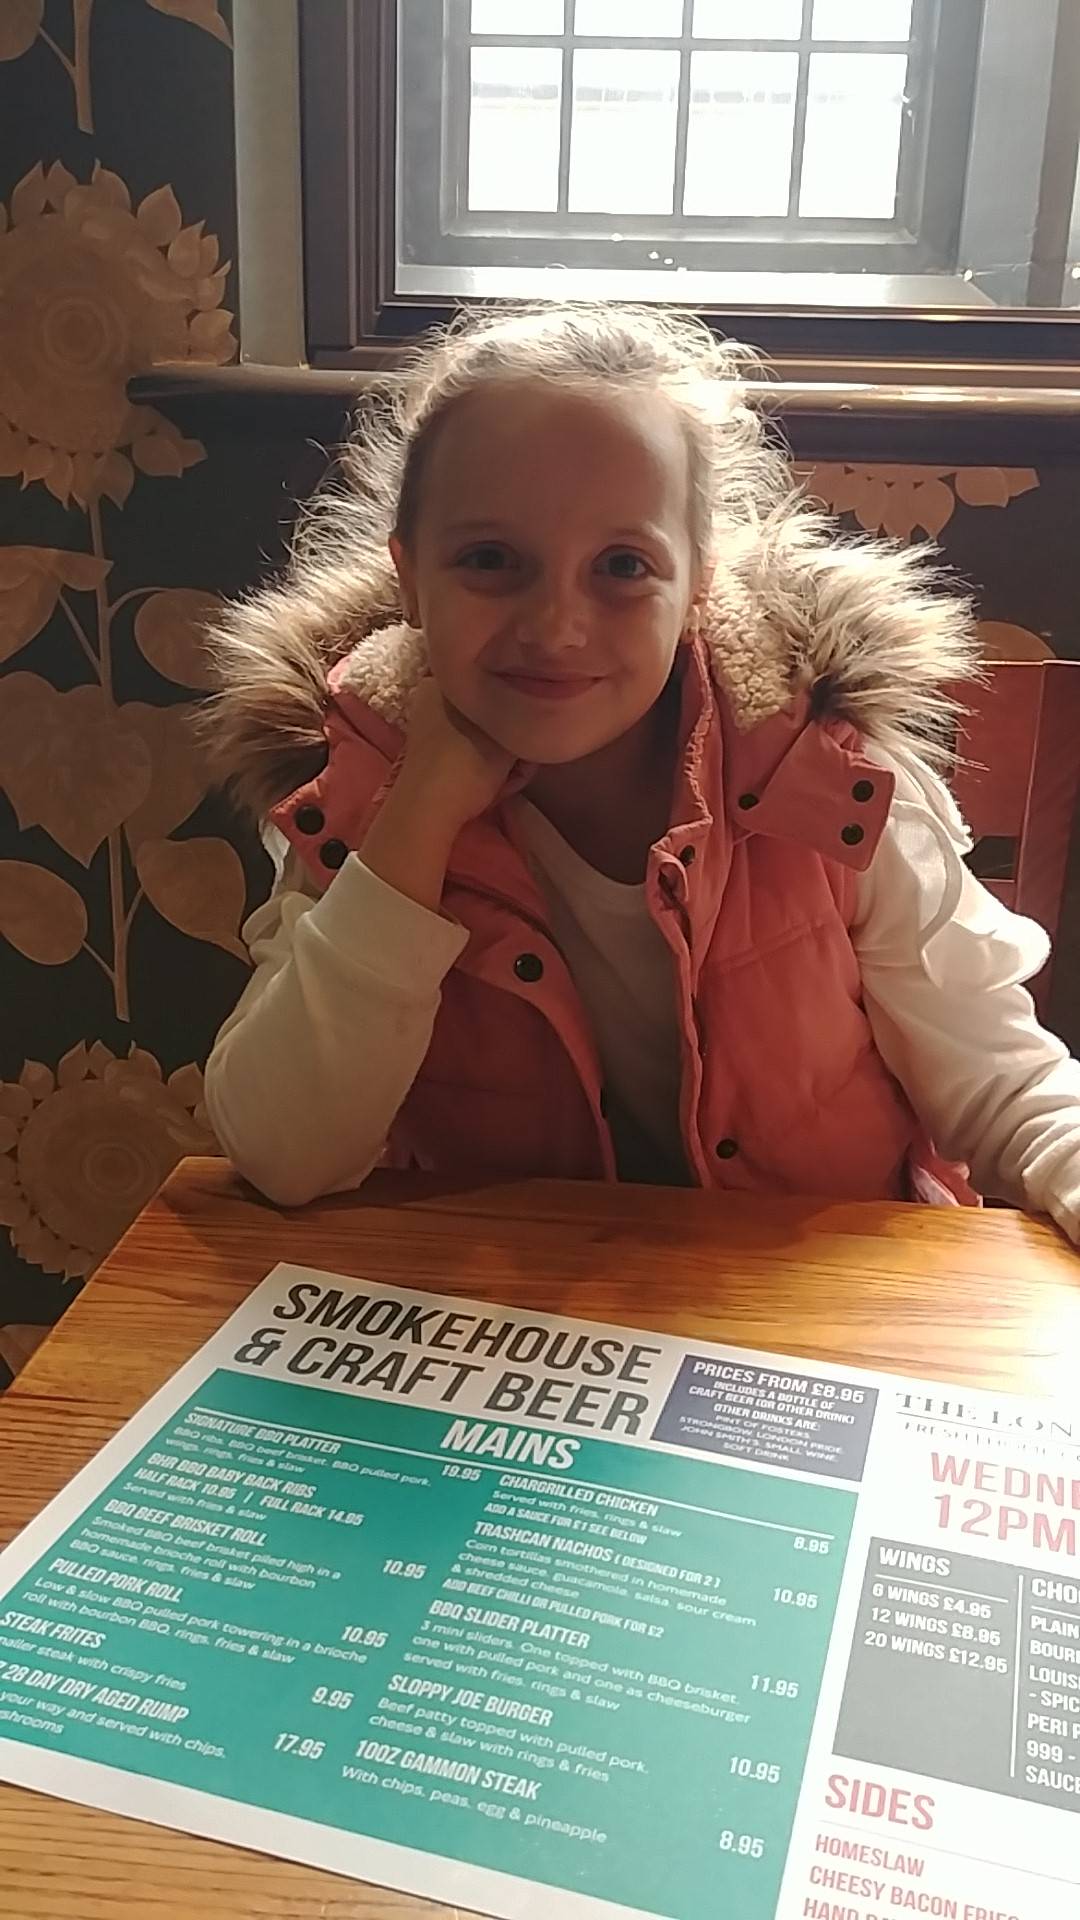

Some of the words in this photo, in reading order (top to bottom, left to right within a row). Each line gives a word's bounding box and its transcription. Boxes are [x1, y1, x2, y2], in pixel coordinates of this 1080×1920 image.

[273, 1283, 662, 1384] SMOKEHOUSE
[234, 1327, 286, 1367] &
[286, 1336, 485, 1402] CRAFT
[484, 1371, 650, 1436] BEER
[689, 1386, 724, 1400] CRAFT
[725, 1393, 754, 1406] BEER
[777, 1401, 814, 1417] OTHER
[693, 1361, 755, 1384] PRICES
[757, 1373, 808, 1393] FROM
[811, 1383, 865, 1404] £8.95
[713, 1381, 766, 1399] INCLUDES
[777, 1392, 819, 1409] BOTTLE
[820, 1401, 836, 1411] OF
[440, 1419, 581, 1470] MAINS
[713, 1404, 749, 1418] OTHER
[751, 1410, 792, 1427] DRINKS
[756, 1432, 808, 1449] LONDON
[146, 1452, 179, 1469] BHR
[175, 1458, 208, 1476] BBQ
[204, 1465, 246, 1483] BABY
[241, 1473, 284, 1492] BACK
[280, 1480, 317, 1498] RIBS
[183, 1411, 257, 1437] SIGNATURE
[253, 1427, 285, 1443] BBQ
[281, 1432, 342, 1454] PLATTER
[441, 1464, 481, 1481] 19.95
[133, 1467, 168, 1483] HALF
[164, 1474, 201, 1492] RACK
[200, 1482, 237, 1499] 10.95
[259, 1494, 289, 1511] FULL
[289, 1501, 327, 1518] RACK
[326, 1508, 364, 1526] 14.95
[497, 1473, 595, 1502] CHARGRILLED
[594, 1491, 659, 1517] CHICKEN
[792, 1535, 829, 1554] 8.95
[934, 1494, 1076, 1556] 12PM
[102, 1498, 137, 1517] BBQ
[132, 1505, 174, 1524] BEEF
[168, 1514, 234, 1538] BRISKET
[228, 1526, 267, 1547] ROLL
[382, 1558, 426, 1579] 10.95
[473, 1520, 552, 1548] TRASHCAN
[550, 1536, 613, 1562] NACHOS
[773, 1587, 818, 1608] 10.95
[879, 1547, 951, 1576] WINGS
[33, 1576, 65, 1591] Low
[64, 1584, 76, 1595] &
[76, 1589, 111, 1603] slow
[111, 1596, 143, 1611] BBQ
[141, 1605, 189, 1622] pulled
[185, 1615, 221, 1630] pork
[221, 1622, 286, 1647] towering
[282, 1636, 301, 1648] in
[311, 1642, 368, 1664] brioche
[47, 1557, 107, 1583] PULLED
[102, 1571, 148, 1593] PORK
[143, 1580, 183, 1602] ROLL
[340, 1625, 388, 1648] 10.95
[441, 1577, 468, 1591] ADD
[465, 1581, 497, 1596] BEEF
[494, 1587, 532, 1605] CHILLI
[530, 1595, 549, 1609] OR
[547, 1599, 592, 1619] PULLED
[590, 1610, 623, 1628] PORK
[622, 1618, 647, 1634] FOR
[646, 1624, 664, 1638] £2
[872, 1583, 884, 1597] 6
[887, 1585, 940, 1608] WINGS
[943, 1596, 992, 1619] £4.95
[872, 1607, 891, 1623] 12
[895, 1611, 948, 1635] WINGS
[951, 1623, 1001, 1646] £8.95
[1031, 1615, 1079, 1639] PLAIN
[0, 1610, 54, 1635] STEAK
[48, 1623, 106, 1648] FRITES
[311, 1686, 354, 1709] 9.95
[36, 1646, 75, 1662] steak
[76, 1655, 109, 1671] with
[109, 1664, 154, 1683] crispy
[153, 1673, 187, 1691] fries
[427, 1599, 464, 1620] BBQ
[461, 1606, 520, 1631] SLIDER
[519, 1618, 590, 1649] PLATTER
[750, 1674, 799, 1698] 11.95
[864, 1631, 888, 1648] 20
[892, 1636, 945, 1660] WINGS
[948, 1648, 1008, 1673] £12.95
[1029, 1664, 1080, 1690] LOUIS
[410, 1635, 441, 1649] one
[442, 1641, 475, 1656] with
[475, 1649, 524, 1667] pulled
[523, 1660, 559, 1676] pork
[562, 1670, 592, 1684] and
[593, 1678, 624, 1692] one
[624, 1686, 643, 1698] as
[645, 1691, 751, 1723] cheeseburger
[0, 1663, 30, 1682] 28
[23, 1669, 64, 1690] DAY
[57, 1677, 97, 1699] DRY
[90, 1686, 140, 1711] AGED
[135, 1697, 189, 1723] RUMP
[273, 1732, 326, 1759] 17.95
[376, 1696, 414, 1714] Beef
[413, 1707, 458, 1726] patty
[459, 1716, 517, 1739] topped
[519, 1732, 554, 1749] with
[555, 1741, 608, 1762] pulled
[387, 1673, 454, 1701] SLOPPY
[450, 1688, 485, 1709] JOE
[483, 1695, 553, 1726] BURGER
[729, 1756, 780, 1783] 10.95
[1027, 1712, 1067, 1737] PERI
[368, 1714, 423, 1735] cheese
[423, 1725, 437, 1738] &
[439, 1730, 477, 1747] slaw
[479, 1740, 514, 1757] with
[516, 1750, 555, 1768] rings
[557, 1758, 570, 1772] &
[573, 1762, 609, 1782] fries
[1026, 1740, 1063, 1763] 999
[341, 1764, 379, 1785] With
[476, 1801, 506, 1819] egg
[508, 1806, 521, 1820] &
[523, 1813, 607, 1843] pineapple
[399, 1750, 482, 1785] GAMMON
[480, 1769, 541, 1800] STEAK
[718, 1829, 764, 1858] 8.95
[824, 1774, 935, 1830] SIDES
[815, 1834, 925, 1877] HOMESLAW
[809, 1865, 886, 1901] CHEESY
[890, 1886, 957, 1919] BACON
